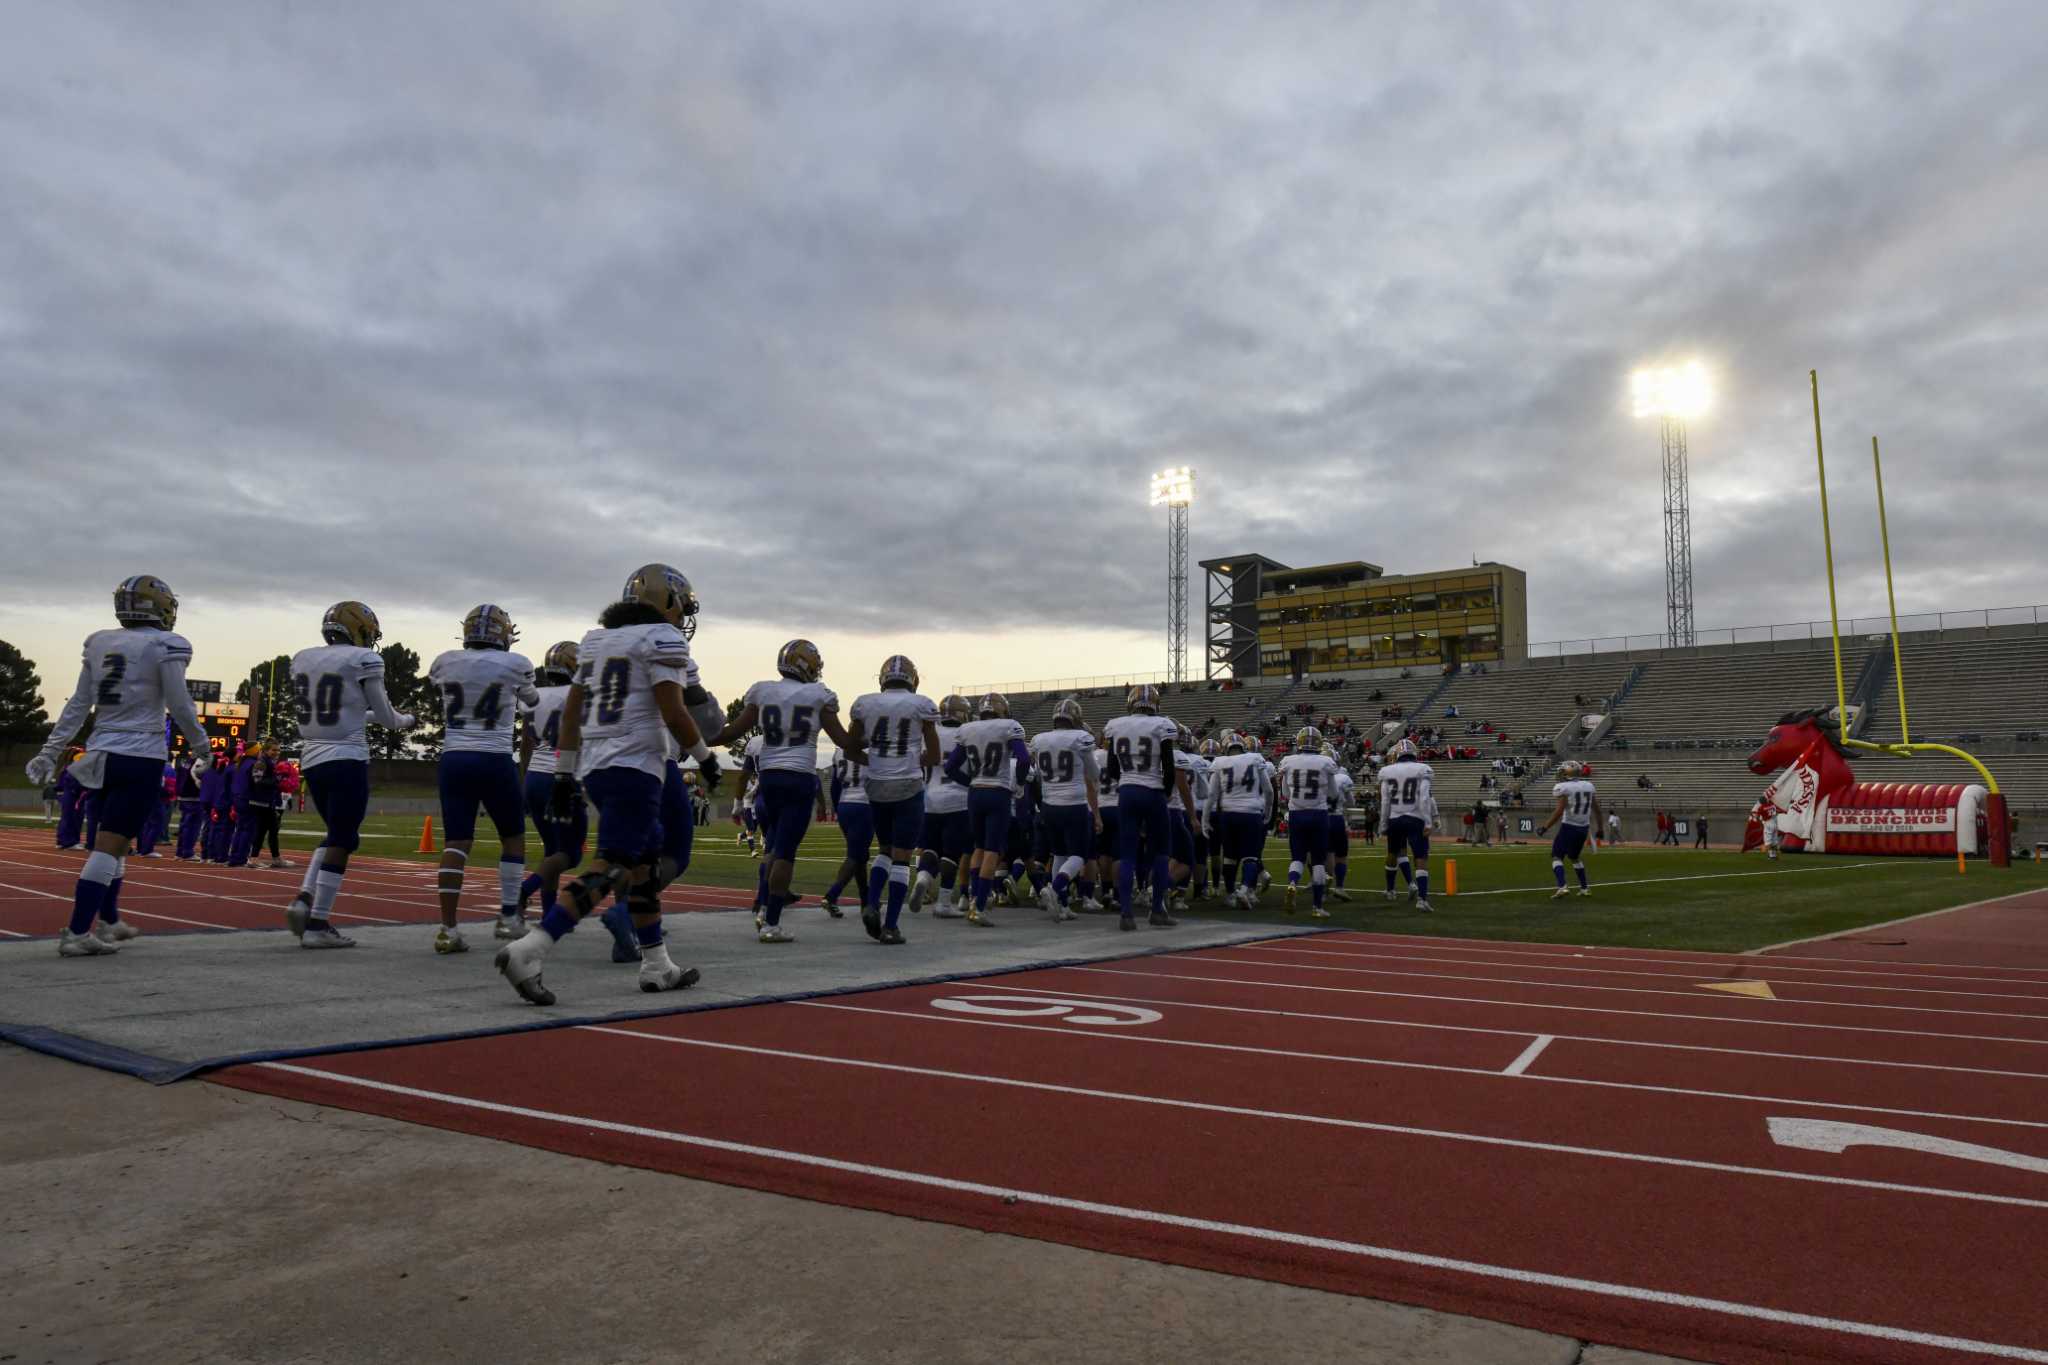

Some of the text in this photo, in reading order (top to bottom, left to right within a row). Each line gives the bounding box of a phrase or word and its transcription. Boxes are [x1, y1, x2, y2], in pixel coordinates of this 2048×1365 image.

[98, 653, 126, 705] 2
[443, 681, 505, 730] 24
[761, 703, 815, 747] 85
[871, 716, 911, 758] 41
[1292, 769, 1321, 800] 15
[1520, 819, 1532, 831] 20
[1830, 808, 1948, 816] ODESSA HIGH
[1830, 815, 1948, 825] BRONCHOS
